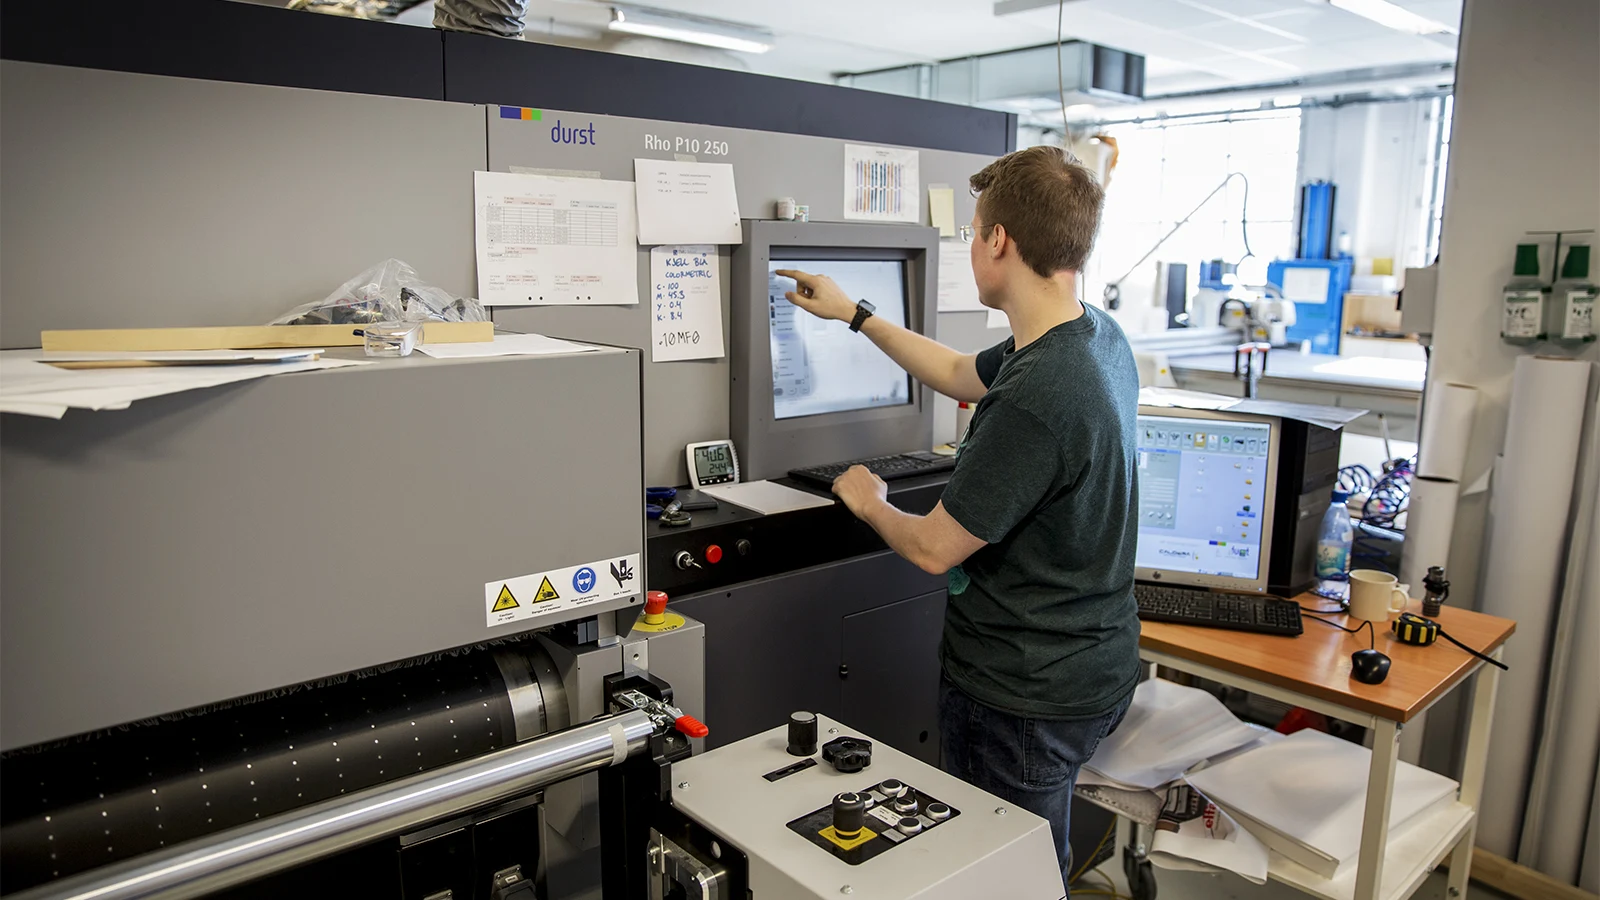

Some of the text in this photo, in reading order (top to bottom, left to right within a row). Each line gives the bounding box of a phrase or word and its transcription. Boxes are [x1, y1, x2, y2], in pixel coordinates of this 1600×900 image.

[551, 119, 596, 145] durst
[645, 134, 729, 156] Rho P10 250
[665, 257, 690, 267] KJELL
[667, 282, 680, 291] 100
